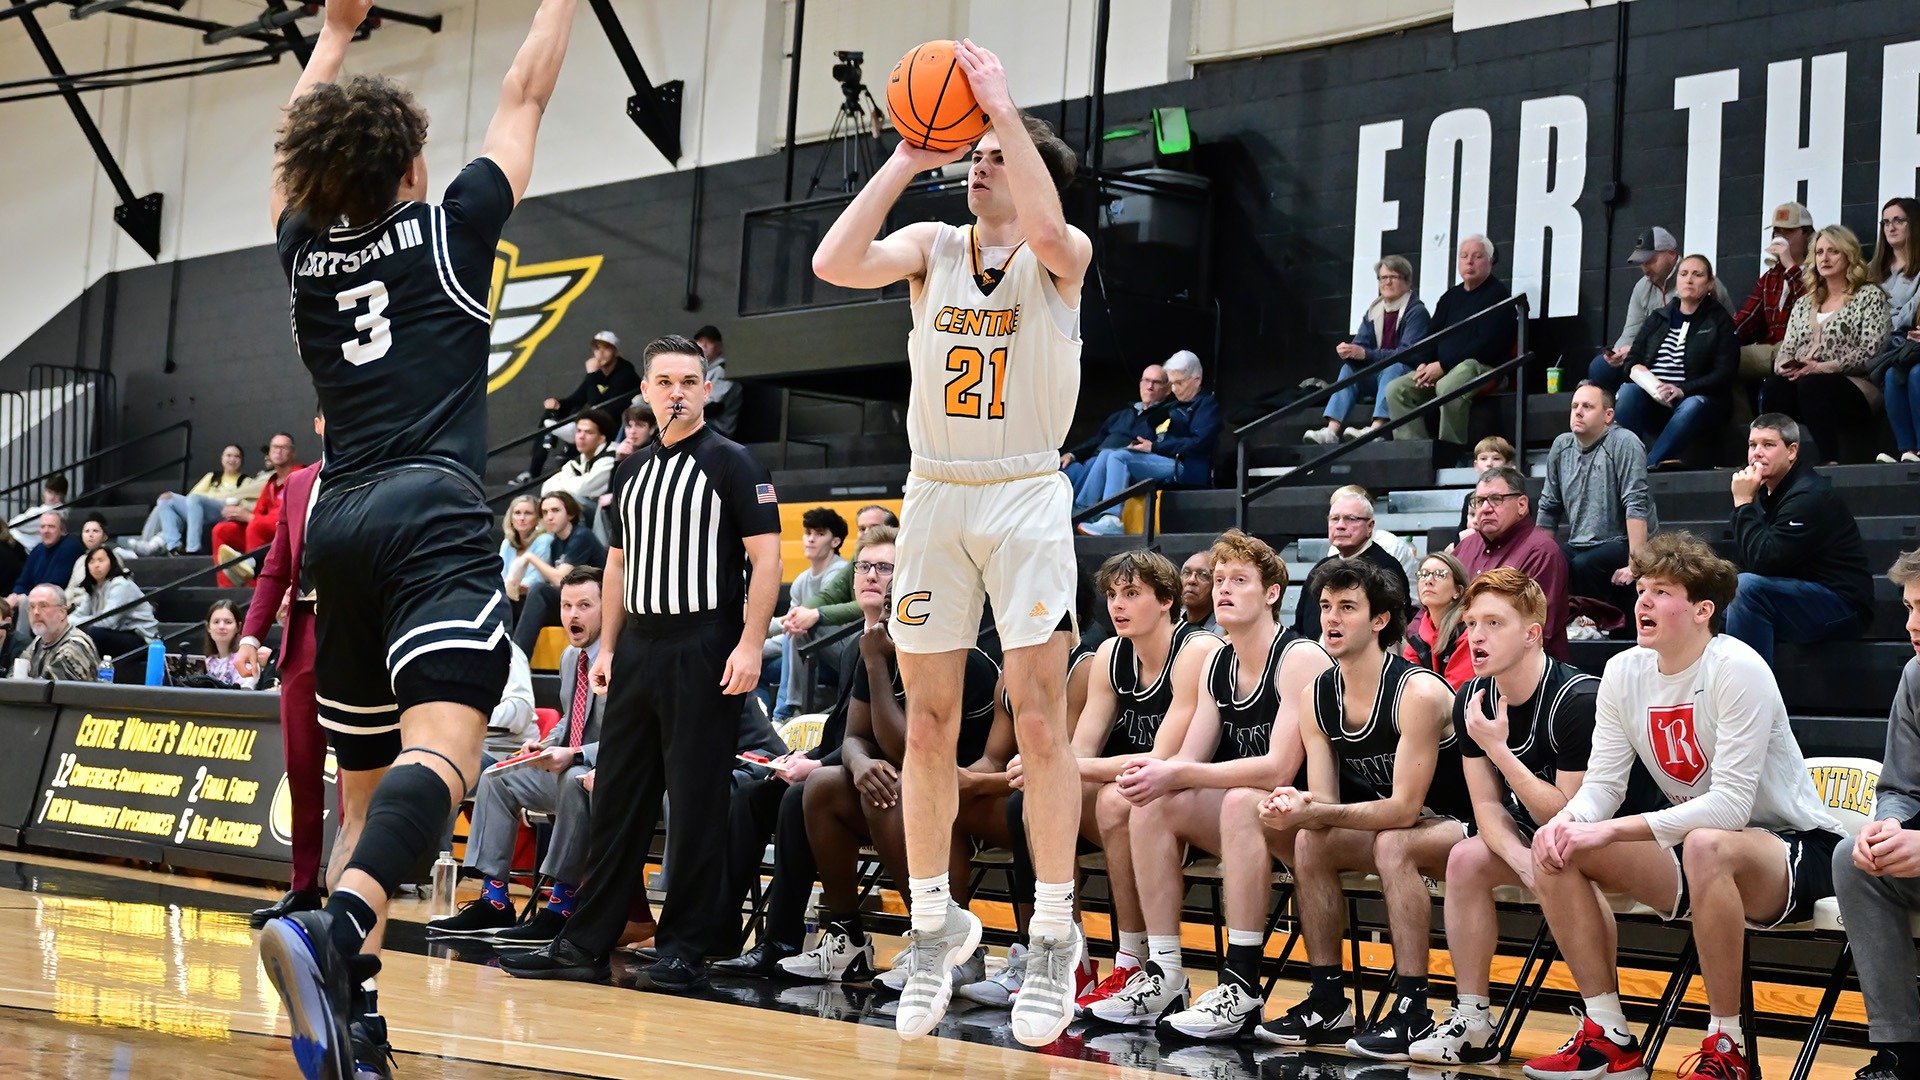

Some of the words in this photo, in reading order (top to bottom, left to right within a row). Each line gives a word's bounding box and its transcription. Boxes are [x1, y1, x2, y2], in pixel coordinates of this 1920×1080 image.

[395, 218, 424, 250] III
[1350, 94, 1588, 335] FOR
[335, 280, 392, 366] 3
[934, 304, 1021, 336] CENTRE
[945, 346, 1008, 419] 21
[119, 717, 180, 754] WOMEN'S
[176, 721, 257, 761] BASKETBALL
[1657, 718, 1699, 768] R
[51, 752, 77, 788] 12
[188, 765, 208, 803] 2
[200, 774, 228, 801] FINAL
[226, 777, 259, 805] FOURS
[1807, 766, 1880, 816] NTRE
[37, 789, 55, 824] 7
[174, 808, 194, 844] 5
[187, 814, 262, 848] ALL-AMERICANS
